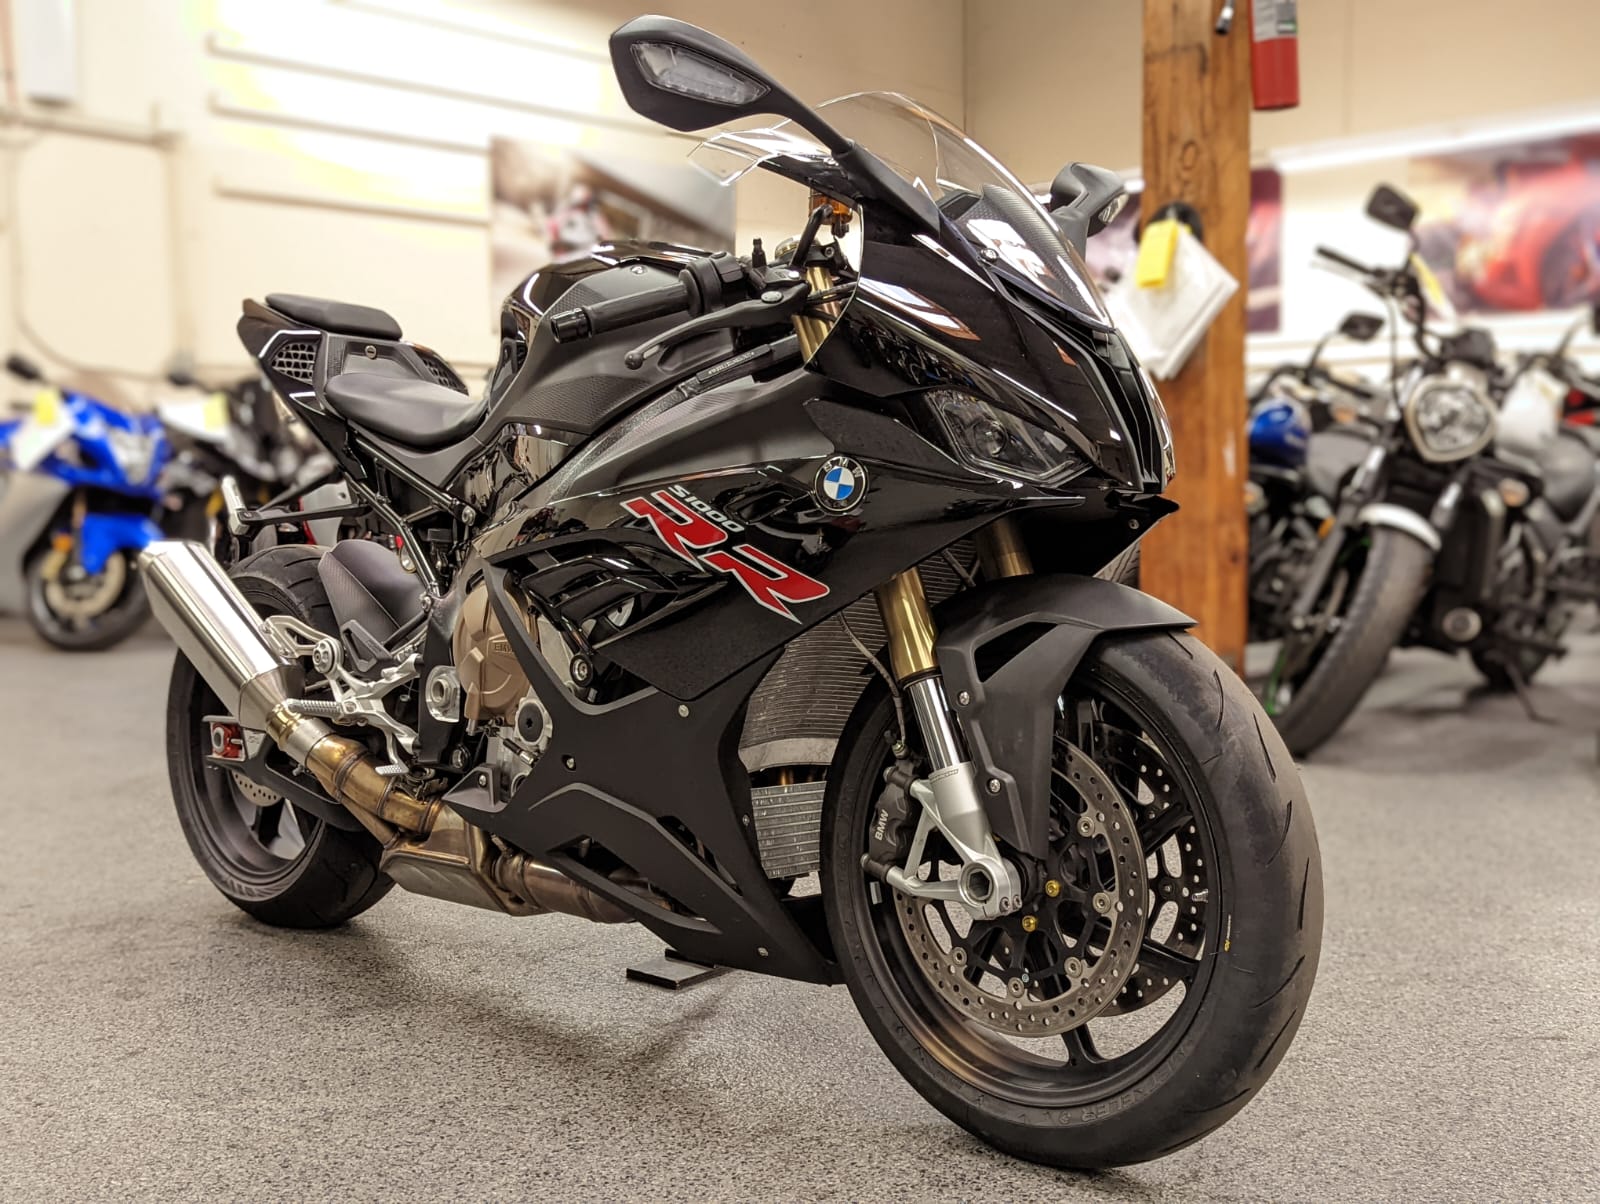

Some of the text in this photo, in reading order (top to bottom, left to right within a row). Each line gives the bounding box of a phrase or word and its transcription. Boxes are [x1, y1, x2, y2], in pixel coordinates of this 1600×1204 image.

[668, 484, 745, 532] S1000
[619, 489, 830, 624] RR
[874, 809, 889, 841] BMW
